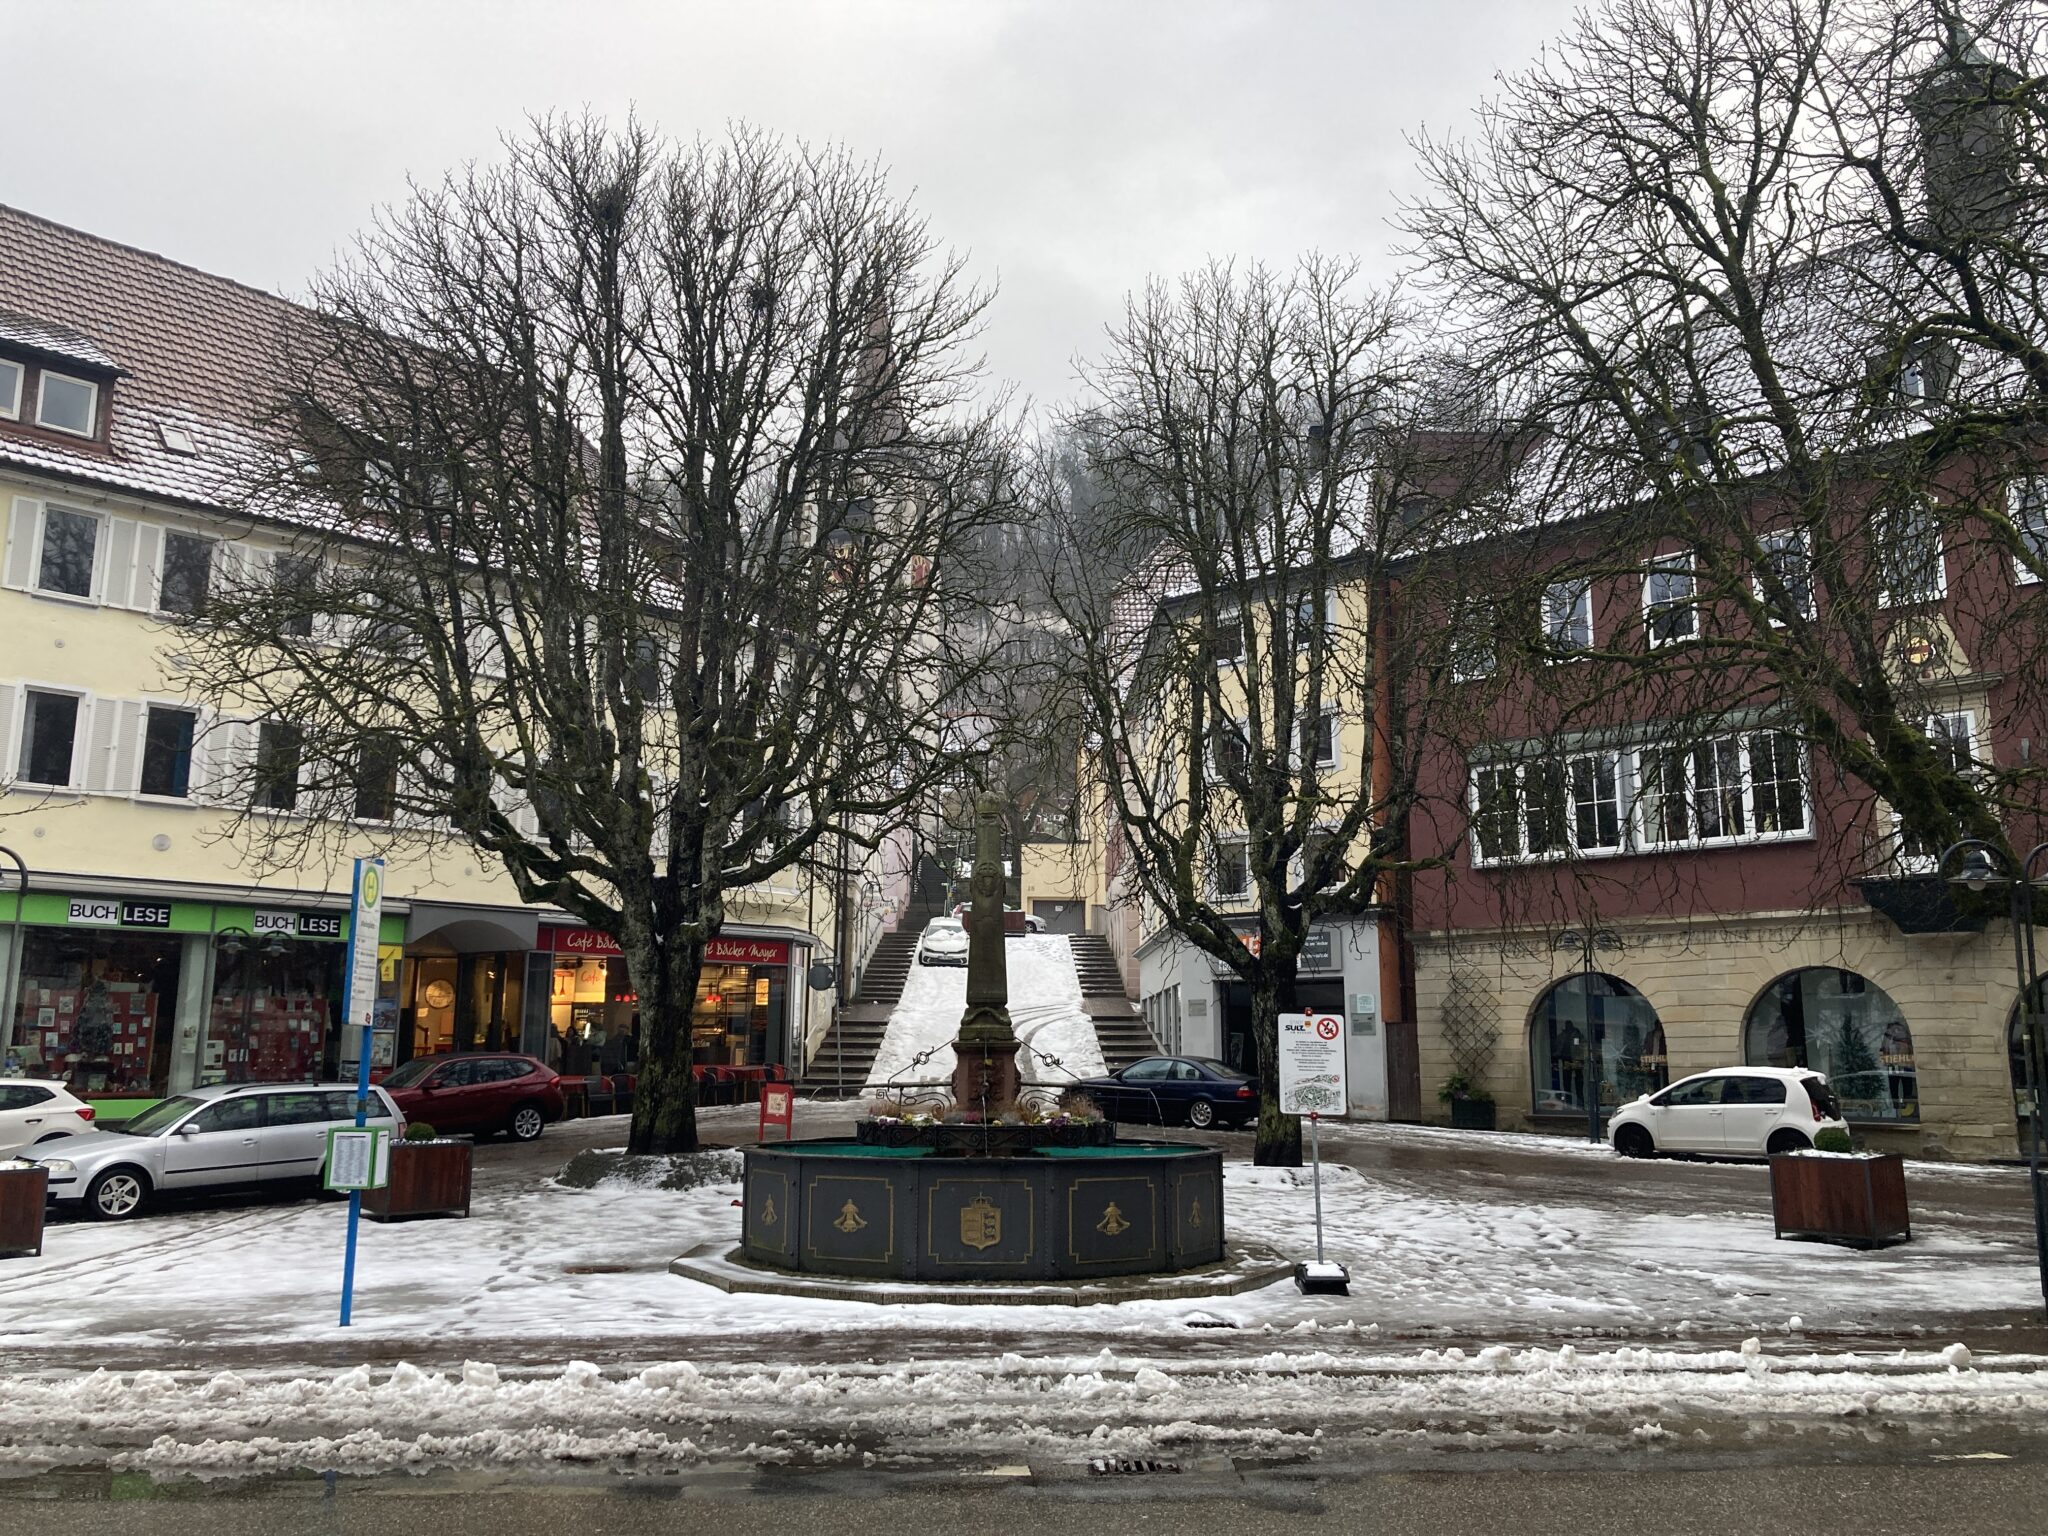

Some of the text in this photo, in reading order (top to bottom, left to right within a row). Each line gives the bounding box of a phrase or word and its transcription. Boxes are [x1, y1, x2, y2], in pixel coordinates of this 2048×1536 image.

[69, 903, 169, 923] BUCH LESE
[254, 915, 340, 933] BUCH LESE
[567, 931, 594, 952] Café
[716, 941, 747, 958] Bäcker
[748, 944, 778, 962] Mayer
[1284, 1024, 1306, 1032] SULZ
